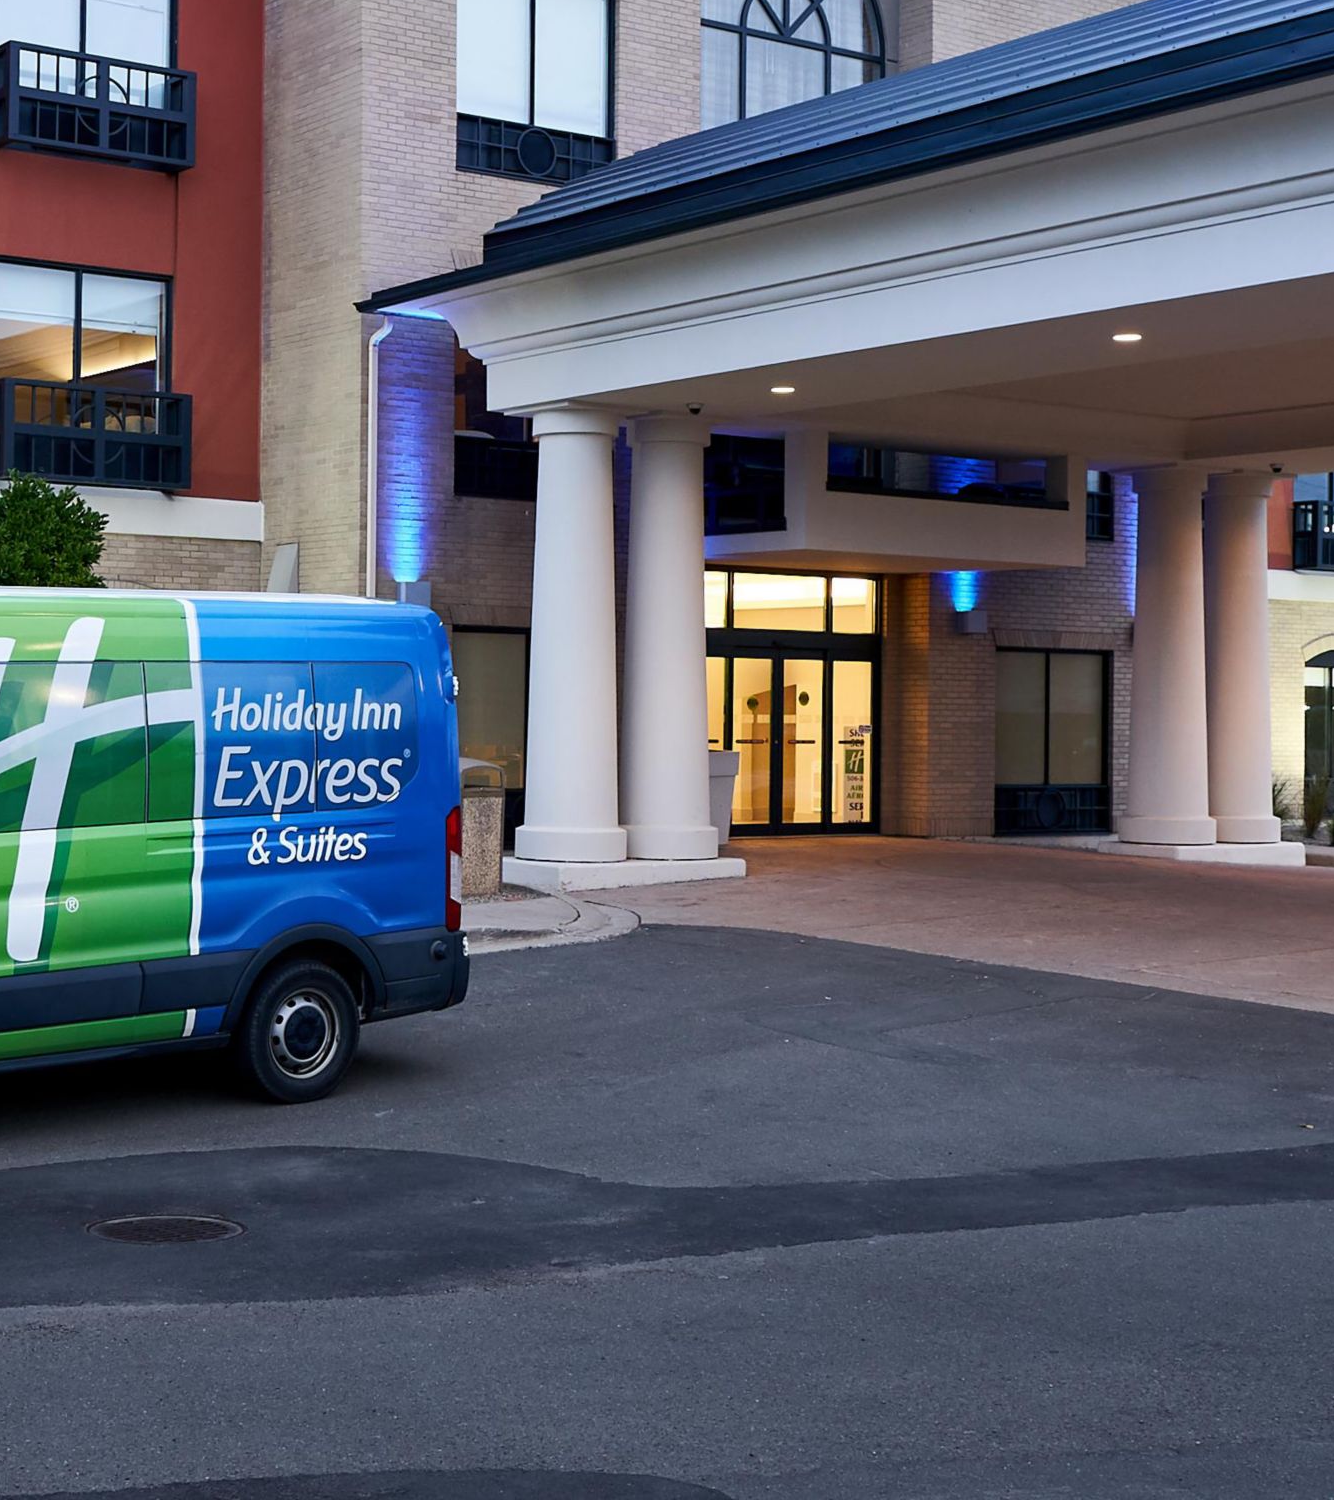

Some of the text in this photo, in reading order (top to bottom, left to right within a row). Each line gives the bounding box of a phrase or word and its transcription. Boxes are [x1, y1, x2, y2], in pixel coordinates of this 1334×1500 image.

[212, 687, 402, 741] Holiday Inn
[213, 745, 403, 822] Express
[247, 826, 367, 866] & Suites
